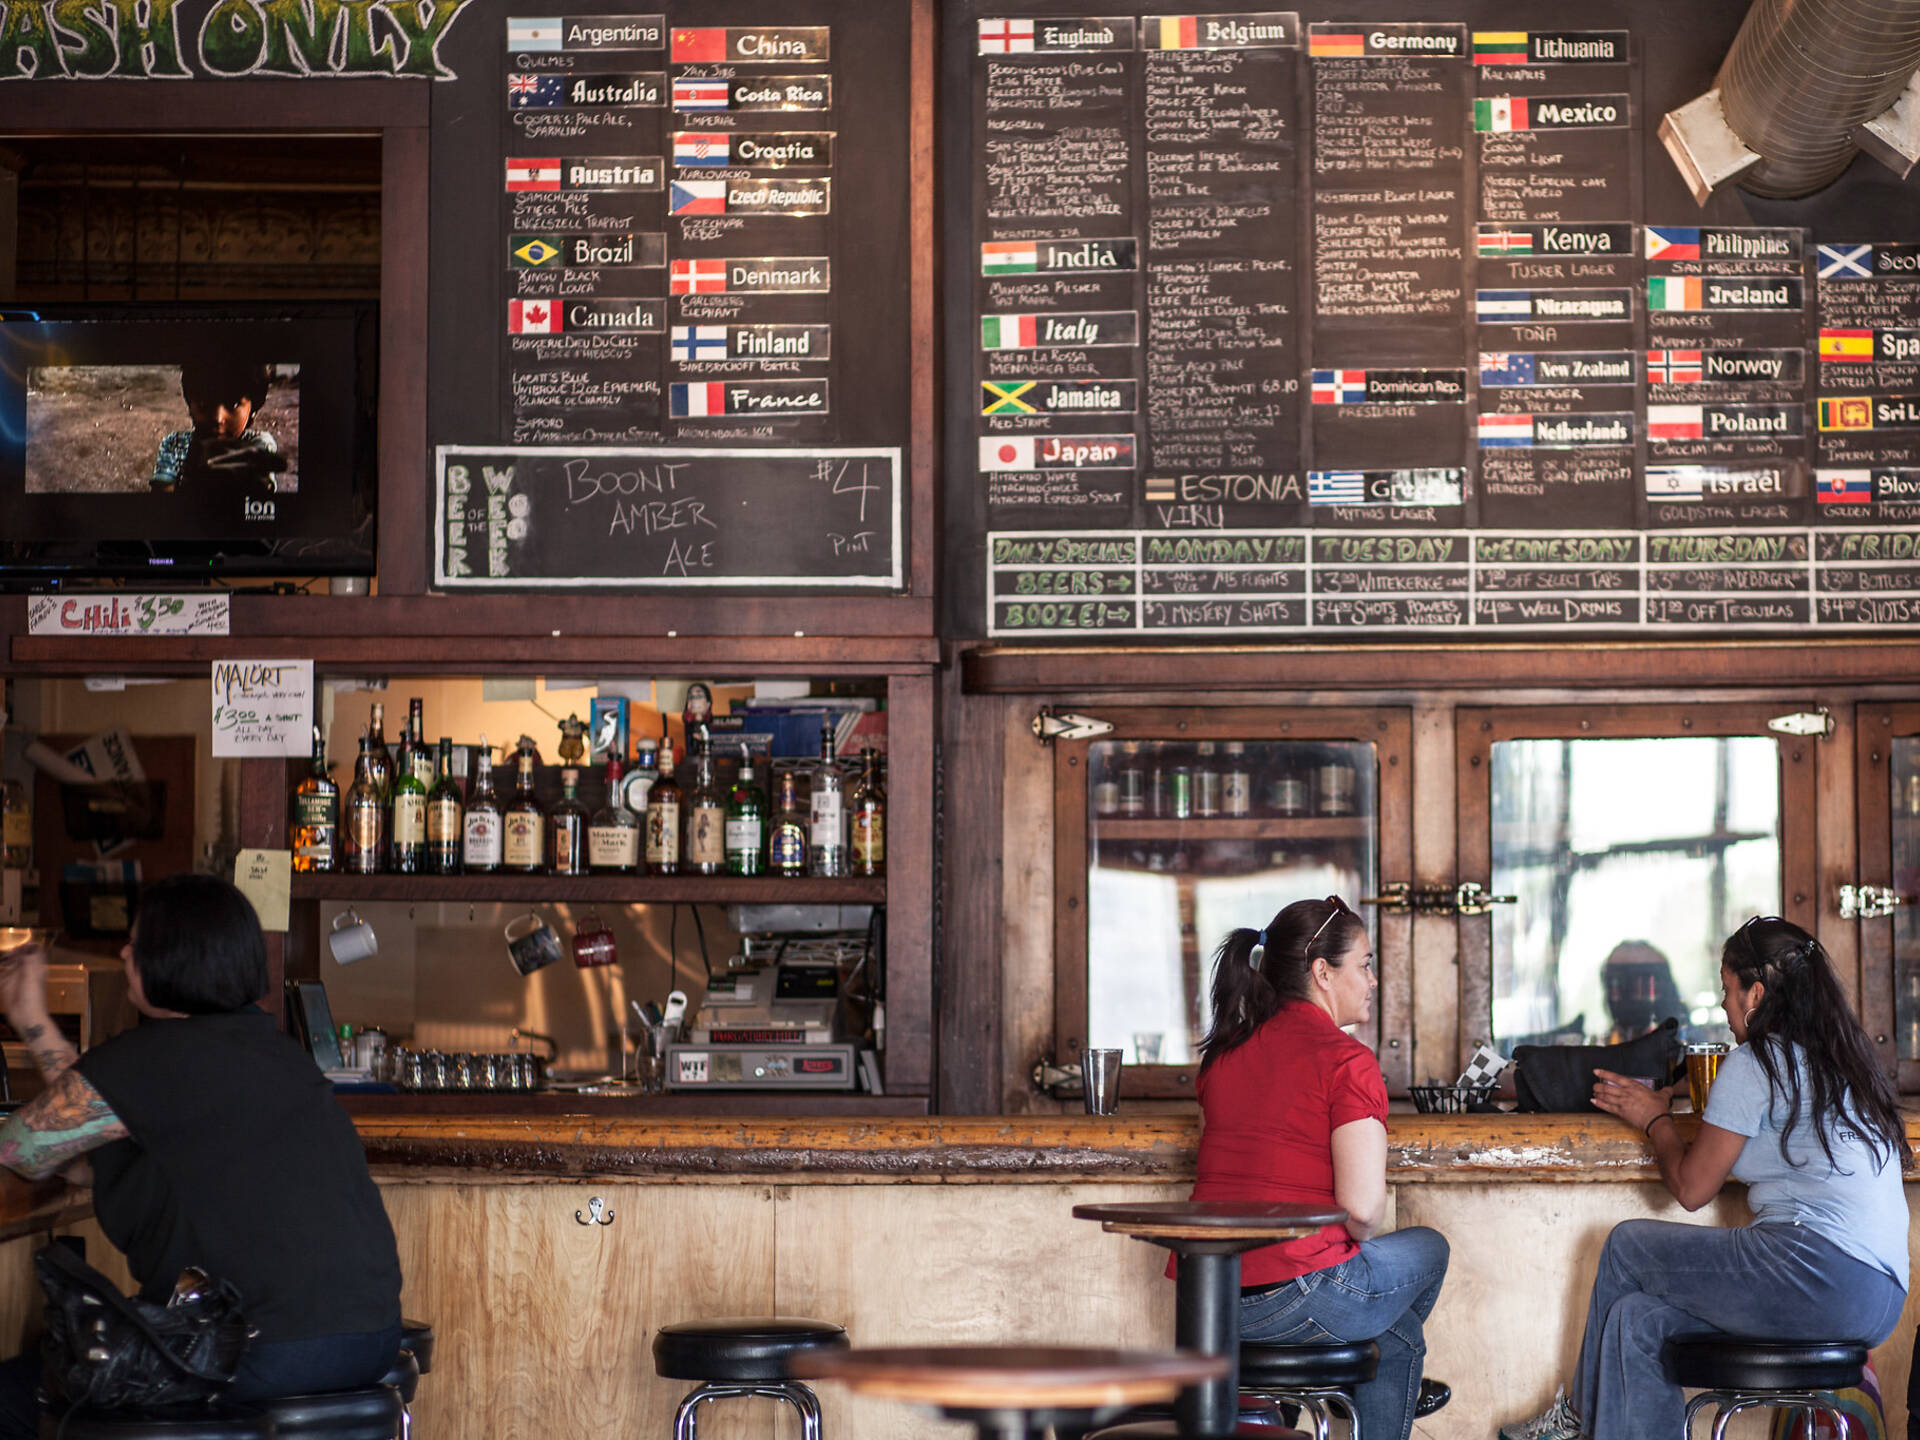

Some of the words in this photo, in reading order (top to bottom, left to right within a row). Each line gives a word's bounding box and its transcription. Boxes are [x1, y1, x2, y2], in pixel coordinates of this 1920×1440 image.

[199, 0, 473, 81] ONLY
[568, 25, 658, 45] Argentina
[1044, 27, 1114, 49] England
[1206, 22, 1285, 44] Belgium
[1370, 32, 1457, 53] Germany
[737, 36, 807, 56] China
[1536, 38, 1614, 58] Lithuania
[517, 54, 574, 69] QUILMES
[571, 80, 657, 103] Australia
[735, 88, 780, 102] Costa
[787, 86, 823, 101] Rica
[684, 113, 736, 127] IMPERIAL
[1537, 103, 1617, 123] Mexico
[525, 124, 586, 138] SPARKLING
[739, 143, 814, 159] Croatia
[1482, 143, 1525, 153] CORONA
[1481, 154, 1526, 165] CORONA
[570, 166, 654, 185] Austria
[513, 202, 557, 215] STIEGL
[565, 201, 588, 215] PILS
[728, 190, 765, 204] Czech
[768, 190, 824, 206] Republic
[683, 227, 723, 240] REBEL
[1543, 228, 1612, 252] Kenya
[575, 240, 632, 262] Brazil
[1047, 243, 1117, 268] India
[1706, 233, 1790, 258] Philippines
[519, 269, 557, 283] XINGU
[564, 270, 600, 281] BLACK
[733, 267, 821, 286] Denmark
[1508, 262, 1565, 279] TUSKER
[1570, 263, 1615, 278] LAGER
[1672, 262, 1702, 273] SAN
[1709, 286, 1788, 304] Ireland
[569, 306, 654, 327] Canada
[681, 307, 741, 318] ELEPHANT
[1536, 298, 1624, 316] Nicaragua
[1045, 318, 1098, 344] Italy
[736, 331, 810, 355] Finland
[1032, 351, 1047, 362] LA
[561, 371, 590, 383] BLUE
[1540, 361, 1570, 378] New
[1572, 360, 1630, 378] Zealand
[1708, 356, 1782, 379] Norway
[1047, 386, 1121, 408] Jamaica
[1370, 380, 1434, 394] Dominican
[1436, 380, 1462, 395] Rep.
[731, 390, 822, 408] France
[989, 416, 1013, 429] RED
[1014, 415, 1050, 428] STRIPE
[1710, 412, 1787, 432] Poland
[1878, 404, 1905, 421] Sri
[1537, 420, 1627, 440] Netherlands
[1043, 438, 1117, 466] Japan
[563, 459, 692, 503] BOONT
[1181, 474, 1303, 501] ESTONIA
[1487, 483, 1544, 495] HEINEKEN
[1710, 470, 1782, 493] Israel
[245, 496, 275, 515] ion
[467, 508, 487, 521] OF
[1391, 507, 1436, 521] LAGER
[1659, 505, 1734, 521] GOLDSTAR
[1741, 504, 1789, 519] LAGER
[1824, 505, 1871, 518] GOLDEN
[609, 497, 717, 536] AMBER
[1157, 504, 1224, 529] VIRU
[827, 532, 877, 556] PINT
[995, 539, 1053, 563] DAILY
[1053, 538, 1135, 563] SPECIALS
[1319, 538, 1453, 562] TUESDAY
[1477, 538, 1632, 562] WEDNESDAY
[1651, 535, 1787, 561] THURSDAY
[663, 537, 714, 577] ALE
[1016, 571, 1104, 594] BEERS
[1241, 571, 1289, 587] FLIGHTS
[1356, 571, 1443, 592] WITTEKERKE
[1506, 572, 1532, 588] OFF
[1536, 572, 1580, 588] SELECT
[1859, 571, 1911, 590] BOTTLES
[1005, 603, 1105, 626] BOOZE!
[1172, 601, 1232, 626] MYSTERY
[1240, 601, 1289, 623] SHOTS
[1352, 600, 1396, 625] SHOTS
[1407, 600, 1457, 614] POWERS
[1519, 601, 1561, 617] WELL
[1565, 599, 1622, 622] DRINKS
[1688, 603, 1718, 622] OFF
[1715, 599, 1793, 623] TEQUILAS
[1857, 597, 1910, 623] SHOTS
[265, 714, 272, 722] A
